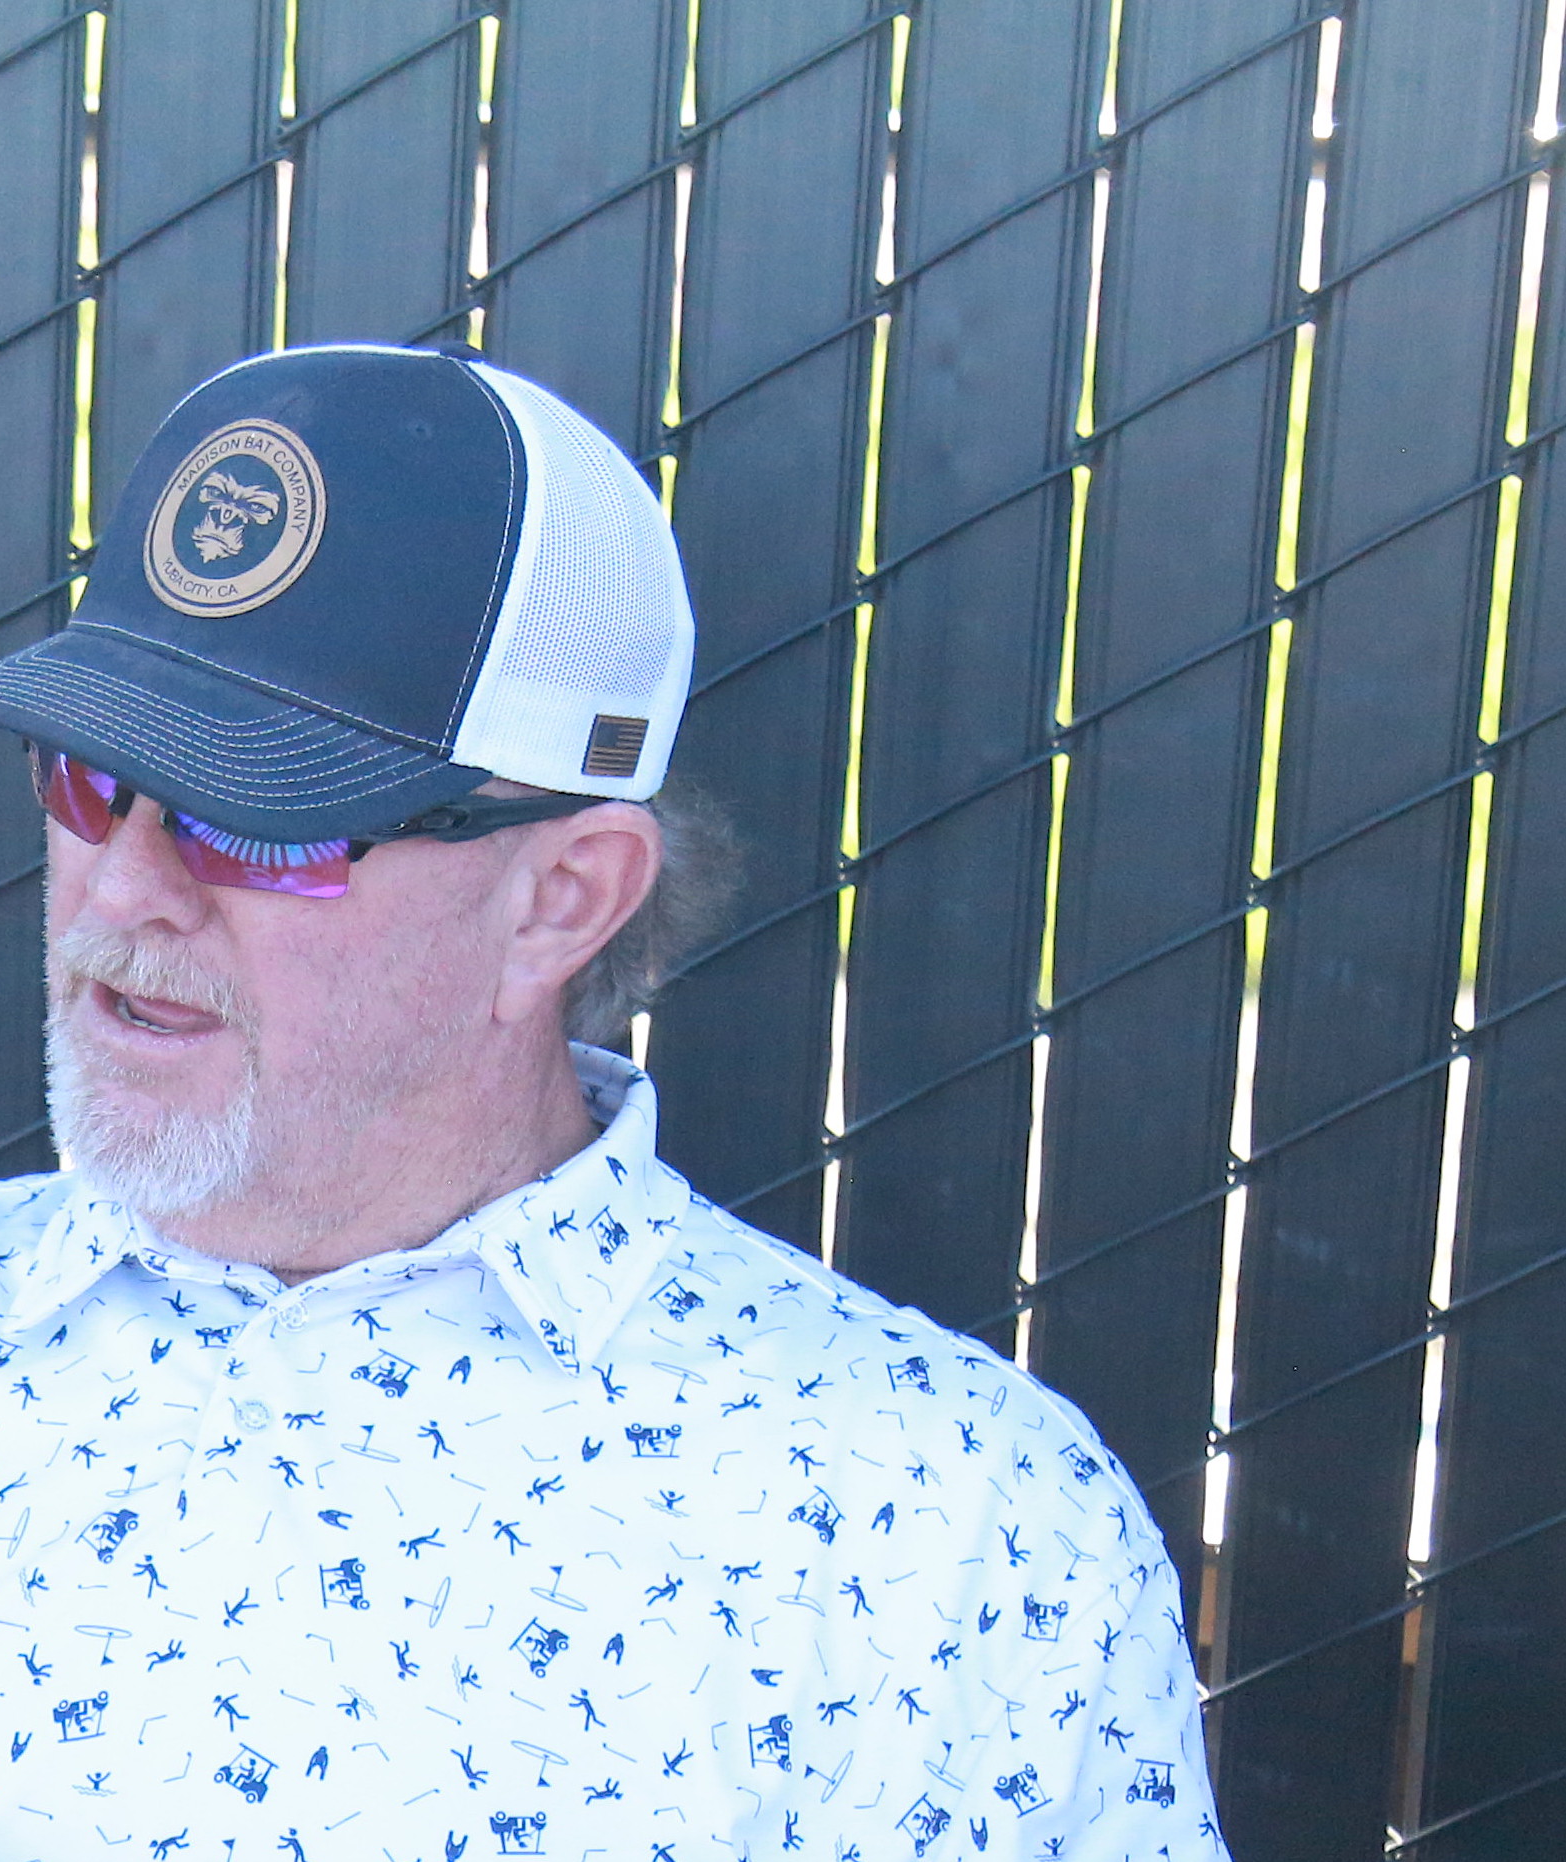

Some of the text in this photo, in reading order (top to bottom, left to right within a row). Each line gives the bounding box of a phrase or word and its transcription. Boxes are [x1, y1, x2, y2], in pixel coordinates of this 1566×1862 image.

[178, 436, 308, 533] MADISON BAT COMPANY
[217, 584, 238, 597] CA
